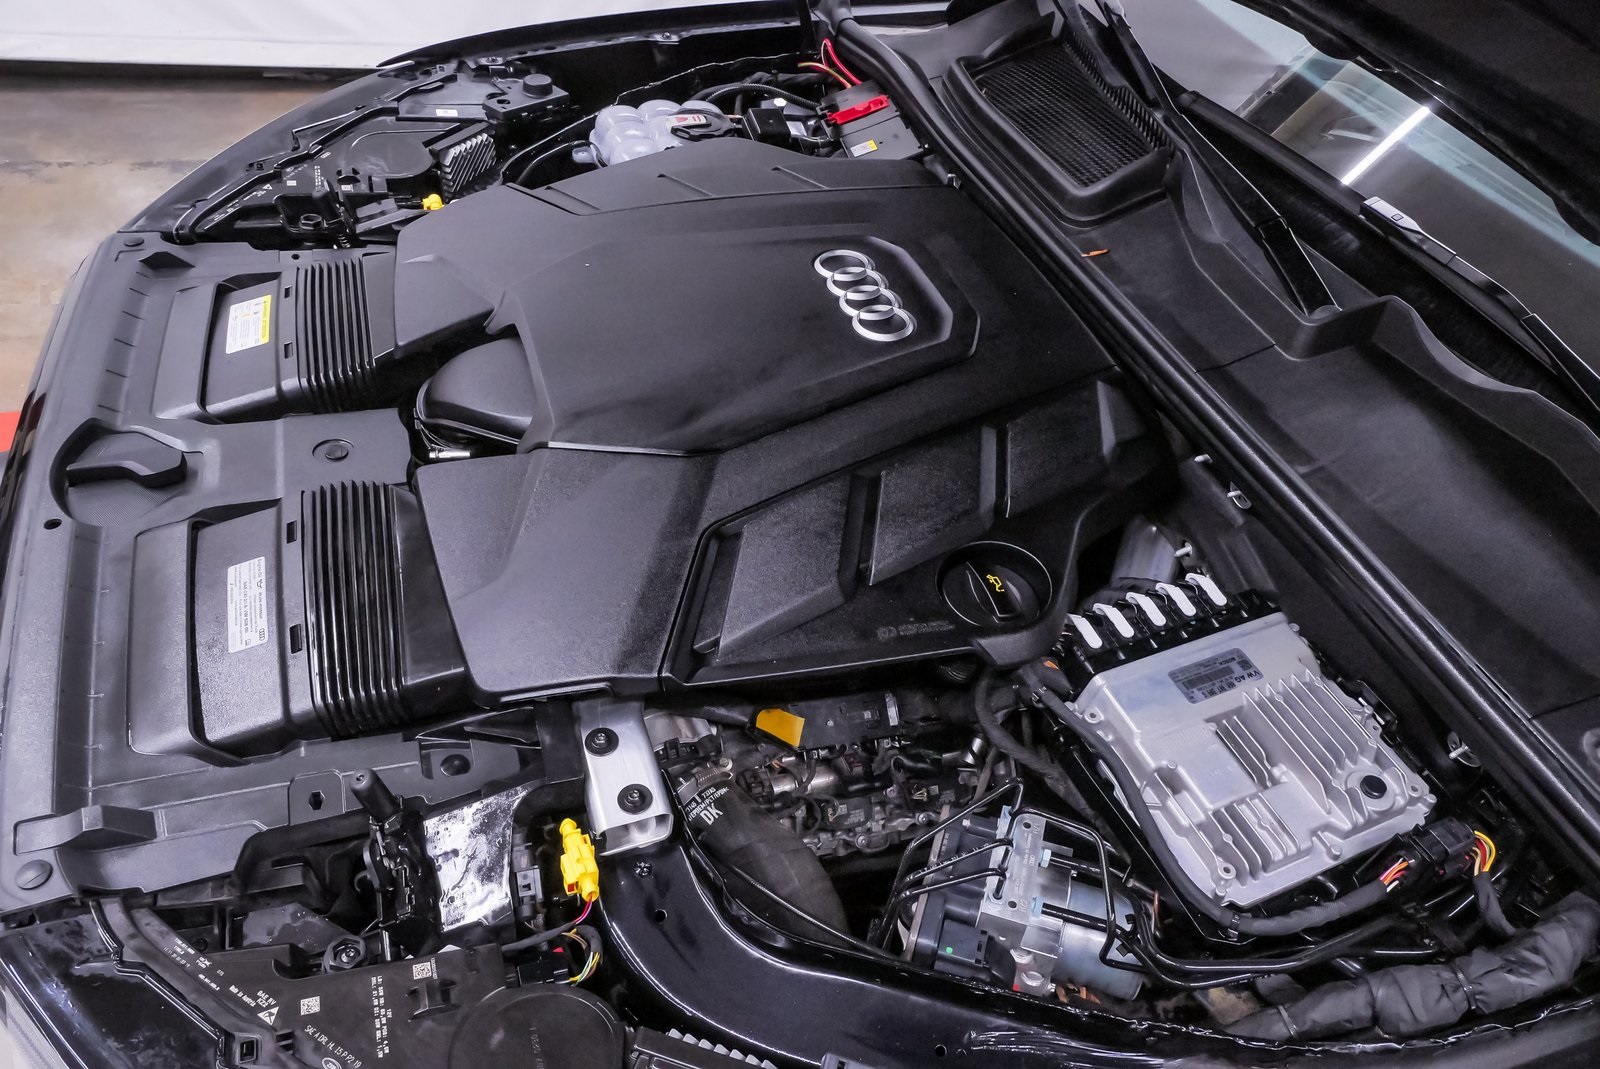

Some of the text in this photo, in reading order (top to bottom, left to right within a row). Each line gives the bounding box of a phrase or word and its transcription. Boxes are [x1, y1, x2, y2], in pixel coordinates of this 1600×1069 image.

[1235, 675, 1246, 683] AG
[1247, 670, 1260, 679] VW
[700, 803, 724, 826] DK
[304, 1024, 317, 1035] SAE
[317, 1034, 328, 1045] DRL
[353, 1060, 362, 1068] 19
